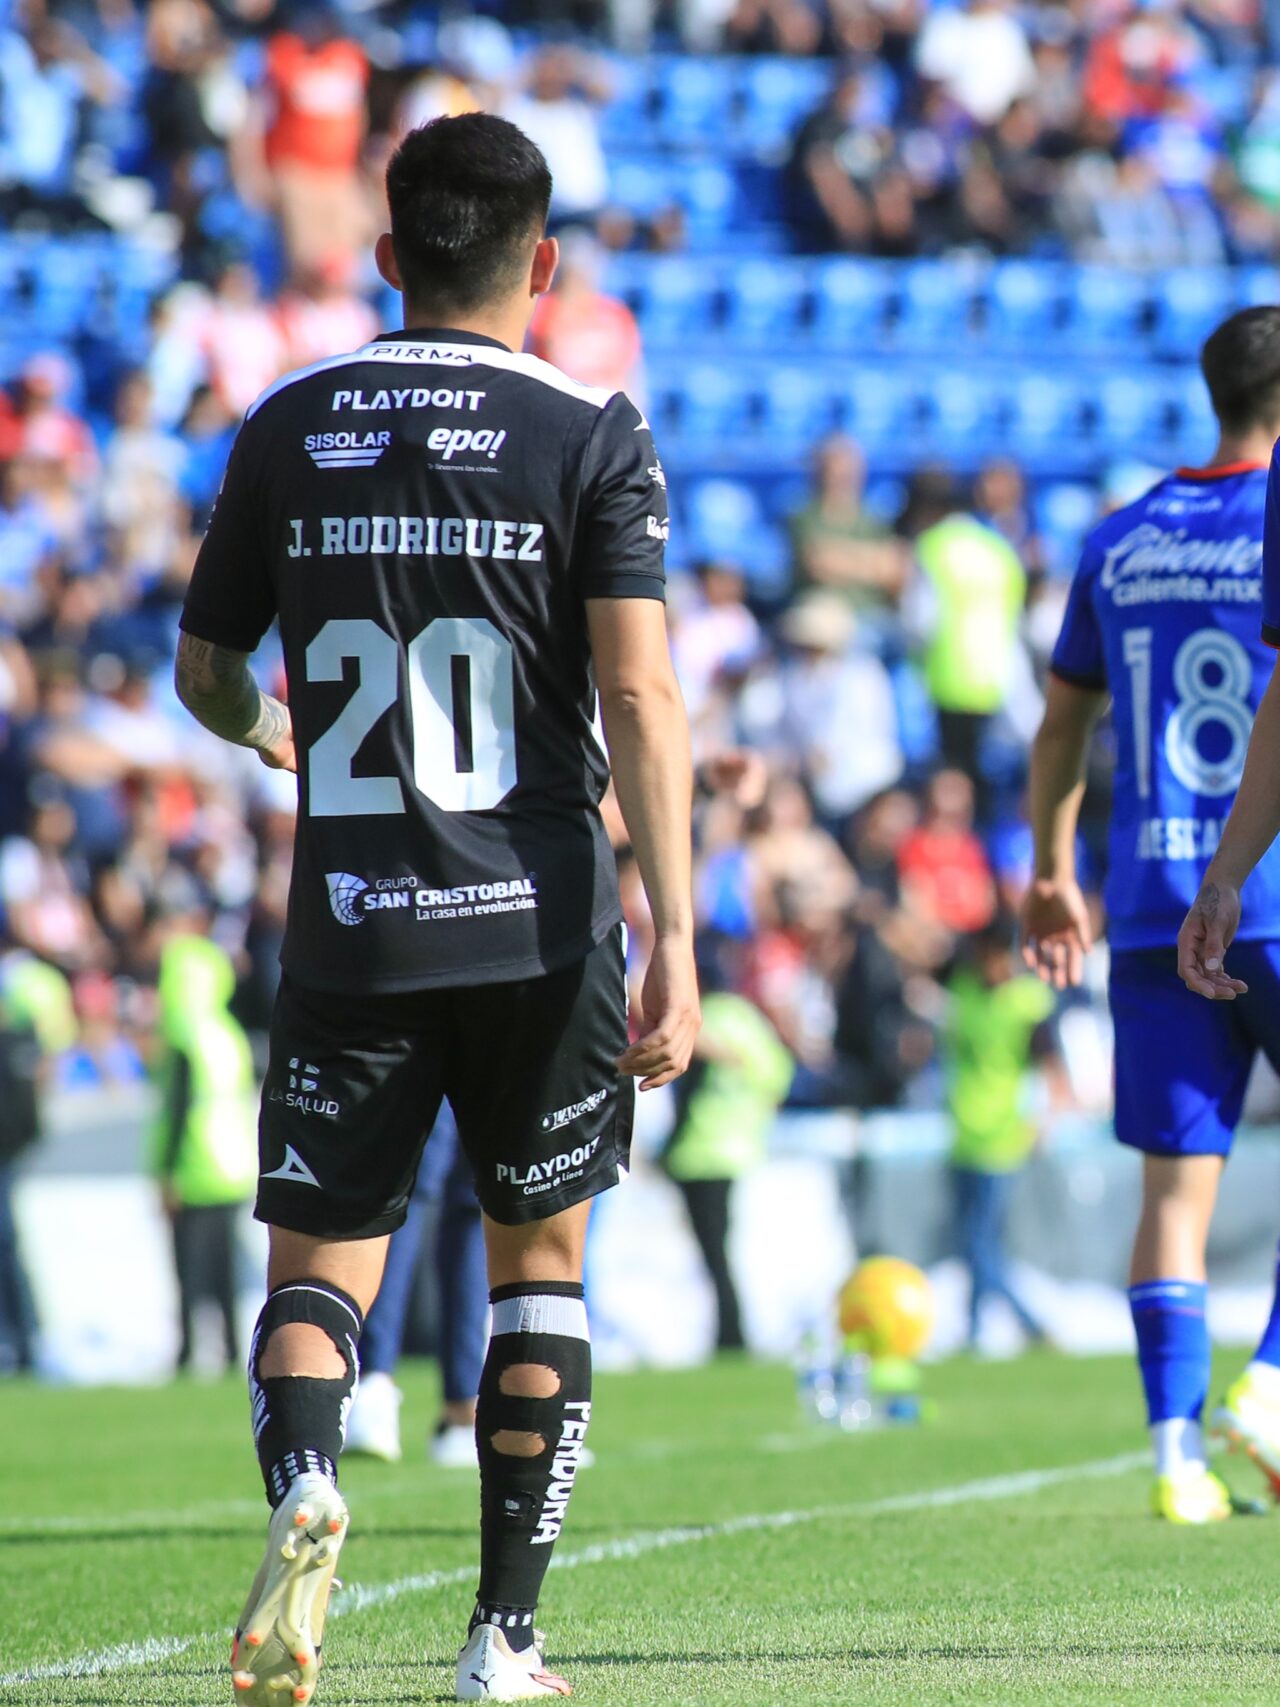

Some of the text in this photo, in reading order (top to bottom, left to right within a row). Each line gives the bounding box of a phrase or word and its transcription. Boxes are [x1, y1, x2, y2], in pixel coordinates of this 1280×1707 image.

[332, 388, 486, 411] PLAYDOIT
[304, 431, 391, 450] SISOLAR
[426, 427, 507, 461] epa!
[288, 516, 544, 562] J. RODRIGUEZ
[305, 617, 518, 818] 20
[1122, 627, 1254, 799] 18
[375, 876, 418, 891] GRUPO
[363, 890, 409, 911] SAN
[416, 908, 430, 921] La
[431, 906, 457, 919] casa
[458, 905, 473, 917] en
[285, 1093, 340, 1115] SALUD
[523, 1182, 552, 1195] Casino
